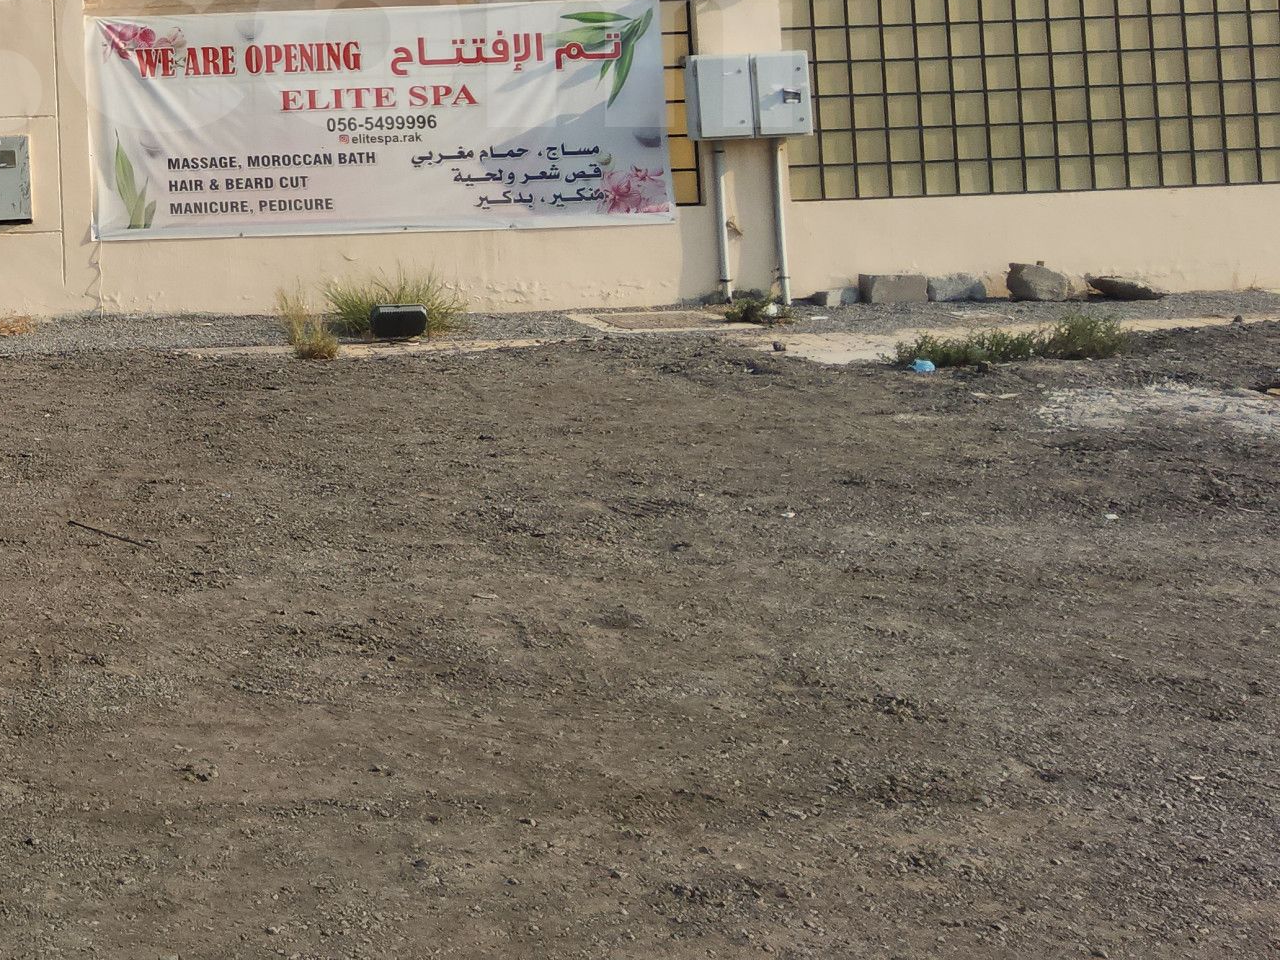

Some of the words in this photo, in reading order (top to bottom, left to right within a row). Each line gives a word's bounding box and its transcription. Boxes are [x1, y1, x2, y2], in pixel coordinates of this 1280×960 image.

[135, 47, 176, 78] WE
[185, 45, 236, 76] ARE
[245, 41, 362, 74] OPENING
[390, 30, 544, 77] الإفتتاح
[555, 31, 622, 70] تم
[280, 86, 397, 112] ELITE
[409, 84, 479, 108] SPA
[326, 114, 437, 132] 056-5499996
[351, 133, 422, 145] elitespa.rak
[167, 156, 242, 170] MASSAGE,
[247, 153, 333, 168] MOROCCAN
[338, 151, 376, 165] BATH
[411, 146, 474, 167] مغربي
[479, 145, 529, 161] حمام
[521, 165, 560, 184] شعر
[565, 163, 602, 183] قص
[168, 178, 203, 192] HAIR
[209, 178, 220, 191] &
[225, 177, 274, 190] BEARD
[279, 175, 309, 188] CUT
[170, 200, 254, 215] MANICURE,
[259, 198, 334, 212] PEDICURE
[474, 190, 533, 209] بدكير
